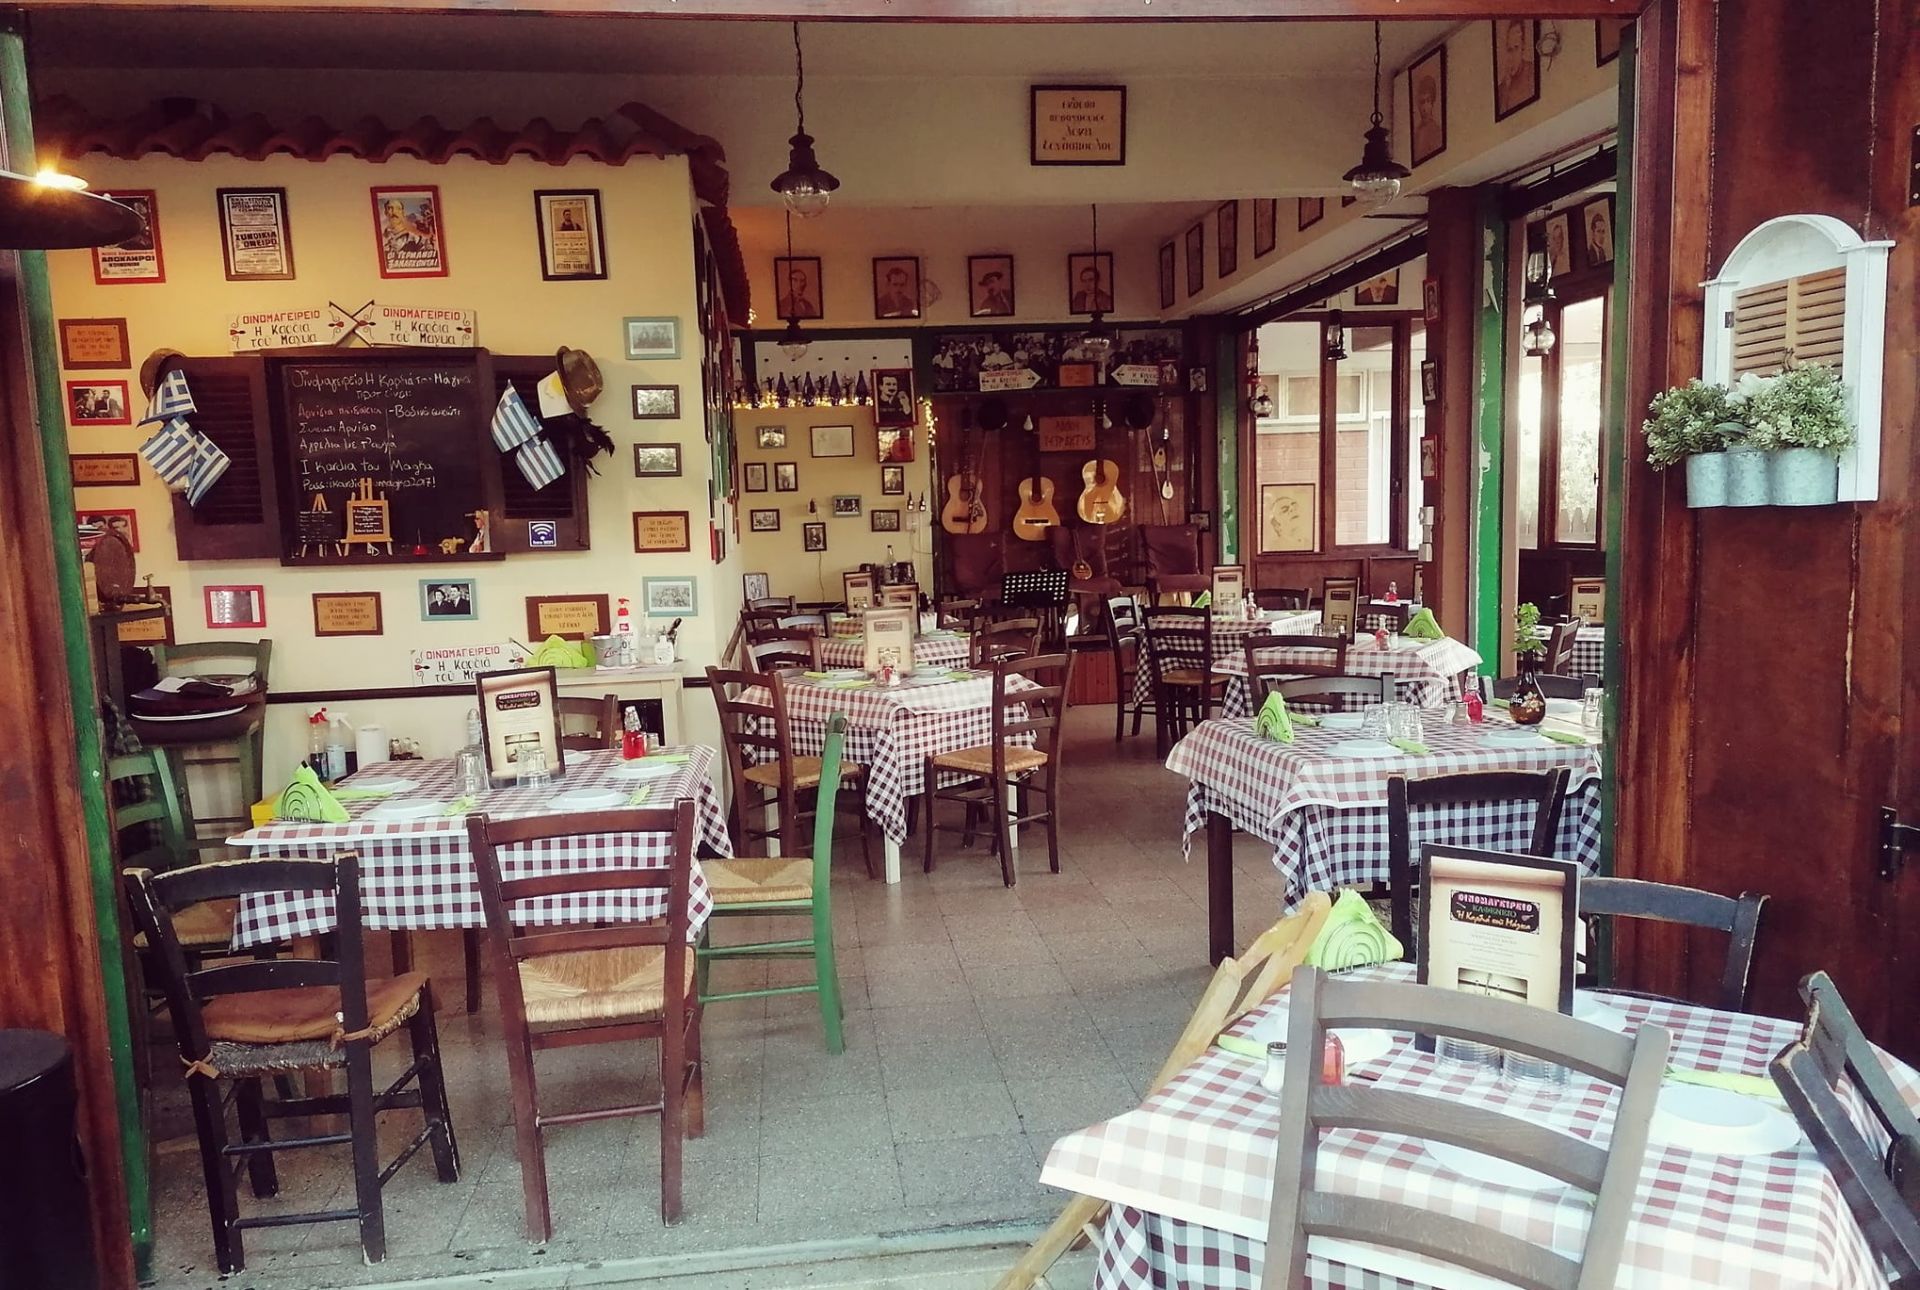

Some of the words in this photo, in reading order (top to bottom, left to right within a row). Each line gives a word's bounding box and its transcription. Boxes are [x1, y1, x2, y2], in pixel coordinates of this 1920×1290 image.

[243, 310, 320, 324] ΟΙΝΟΜΑΓΕΙΡΕΙΟ
[383, 308, 461, 320] ΟΙΝΟΜΑΓΕΙΡΕΙΟ
[426, 646, 500, 660] ΟΙΝΟΜΑΓΕΙΡΕΙΟ
